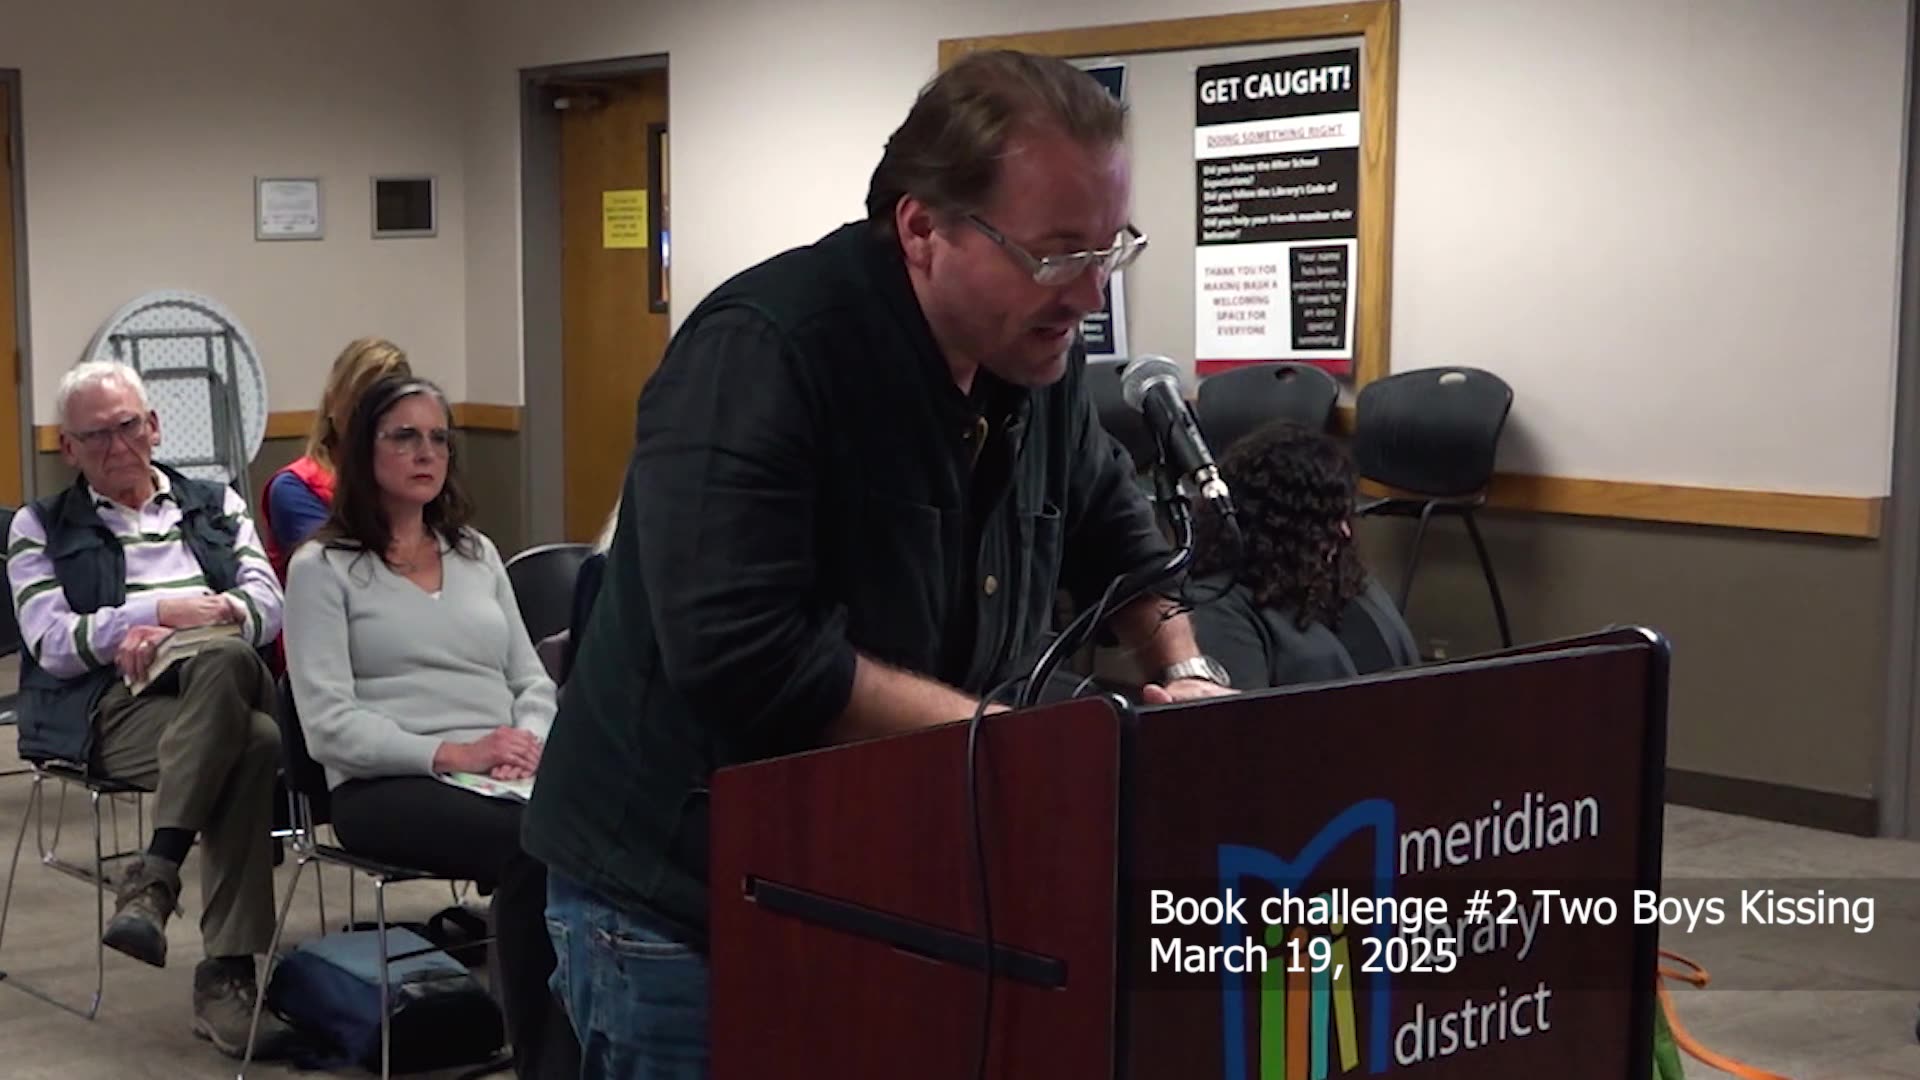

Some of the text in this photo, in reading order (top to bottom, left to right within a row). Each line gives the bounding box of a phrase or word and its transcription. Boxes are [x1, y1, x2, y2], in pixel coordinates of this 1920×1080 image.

[1200, 64, 1352, 104] GET CAUGHT!
[1207, 123, 1343, 148] DOING SOMETHING RIGHT
[1203, 165, 1216, 175] Did
[1217, 165, 1231, 176] you
[1231, 162, 1255, 173] follow
[1256, 161, 1270, 171] the
[1292, 156, 1319, 168] School
[1203, 190, 1217, 201] Did
[1218, 192, 1232, 203] you
[1232, 188, 1256, 199] follow
[1257, 187, 1270, 197] the
[1306, 183, 1326, 194] Code
[1327, 181, 1338, 193] of
[1203, 216, 1217, 227] Did
[1217, 217, 1232, 229] you
[1204, 263, 1277, 276] THANK YOU FOR
[1203, 280, 1241, 291] MAKING
[1272, 279, 1278, 289] A
[1212, 295, 1270, 306] WELCOMING
[1216, 309, 1266, 321] SPACE FOR
[1217, 325, 1266, 336] EVERYONE
[1399, 792, 1599, 875] meridian
[1394, 981, 1552, 1066] district
